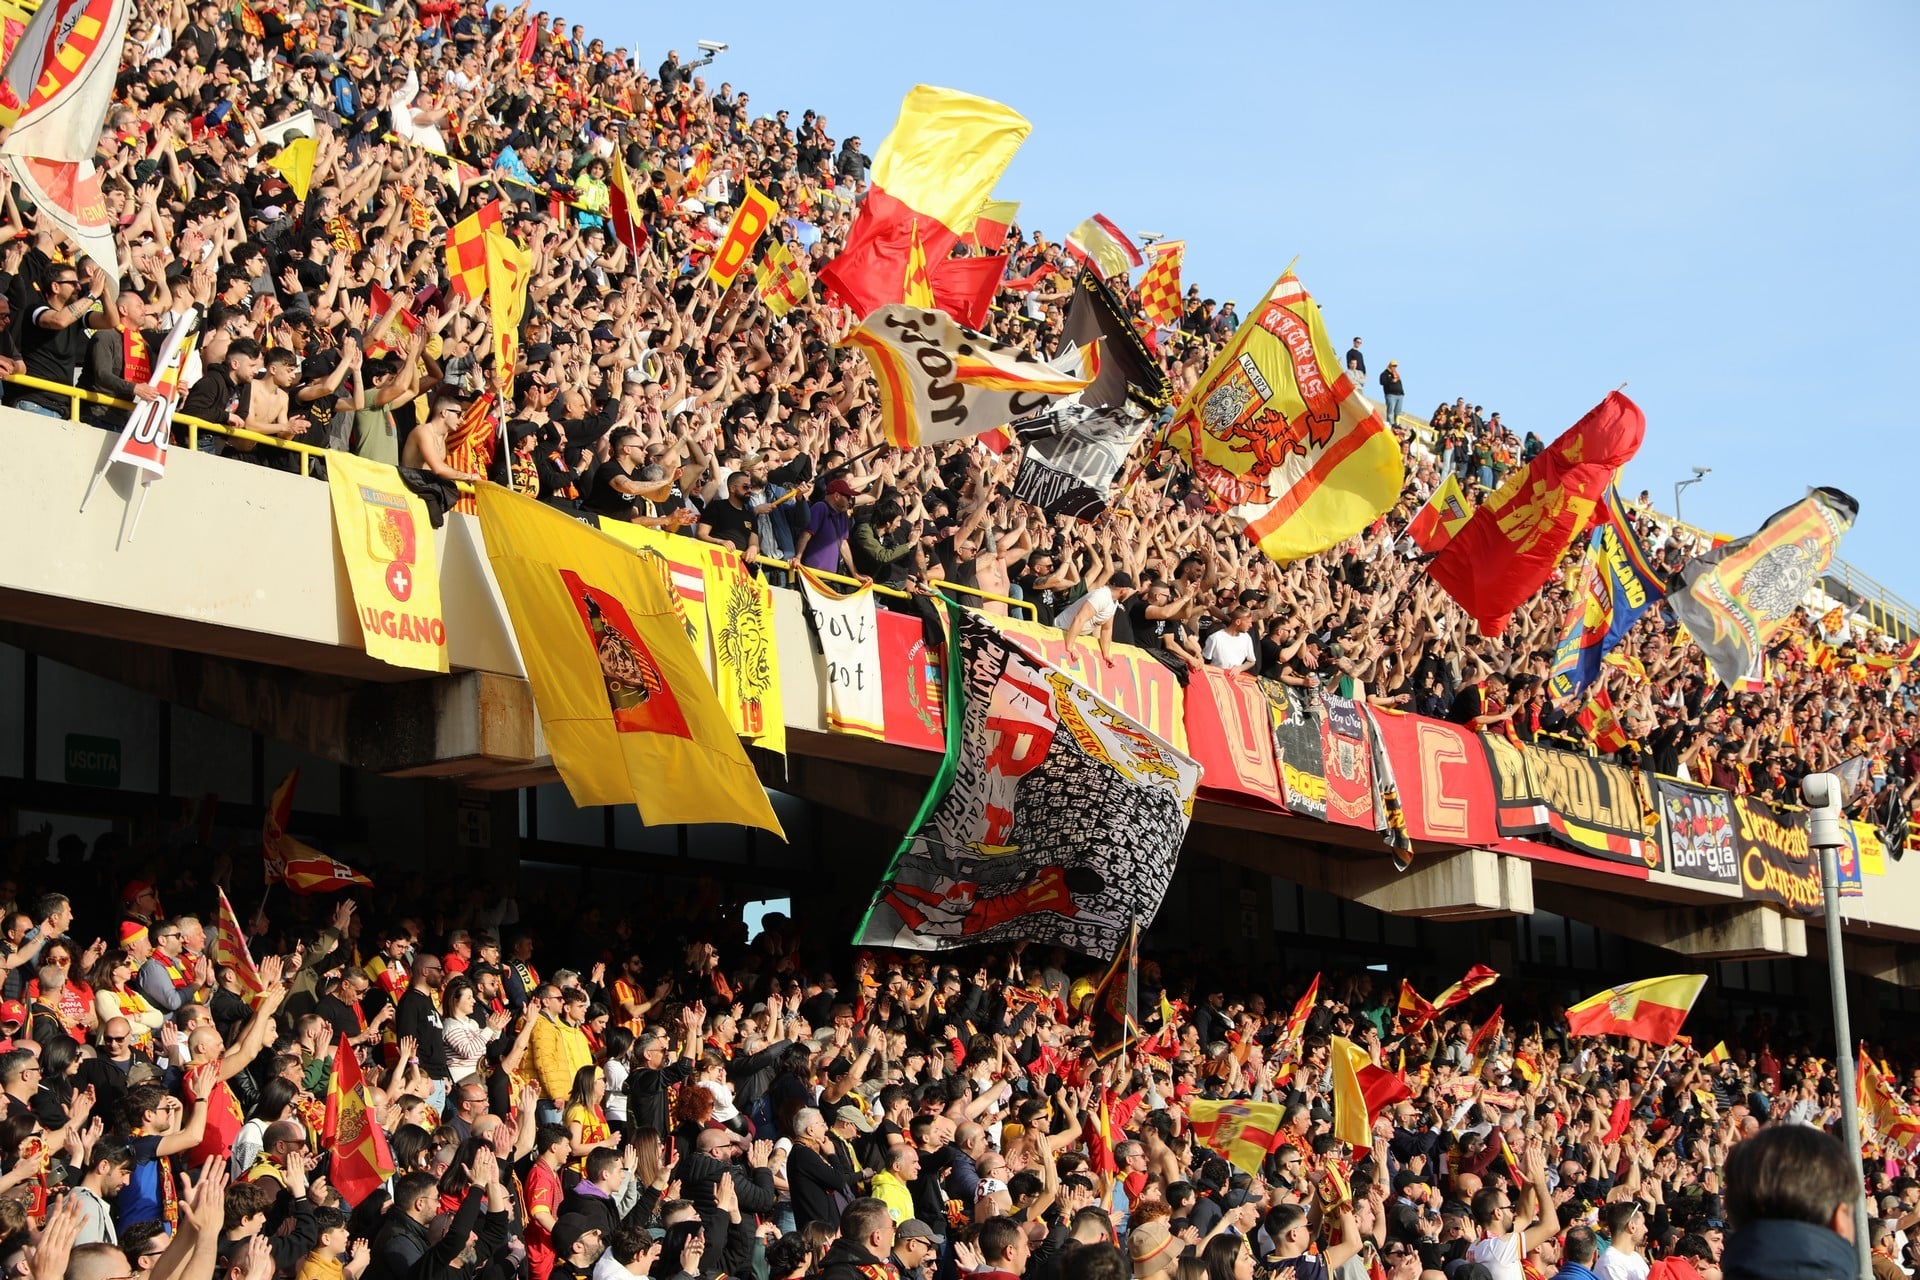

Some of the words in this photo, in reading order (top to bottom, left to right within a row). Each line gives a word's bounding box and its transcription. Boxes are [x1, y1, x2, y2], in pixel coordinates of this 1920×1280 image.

[1265, 308, 1325, 398] ULTRAS
[1253, 375, 1267, 393] 1973
[360, 603, 447, 648] LUGANO
[908, 638, 926, 661] COMUN
[68, 749, 119, 772] USCITA
[1673, 844, 1735, 872] borgia
[1717, 863, 1737, 878] CLAN
